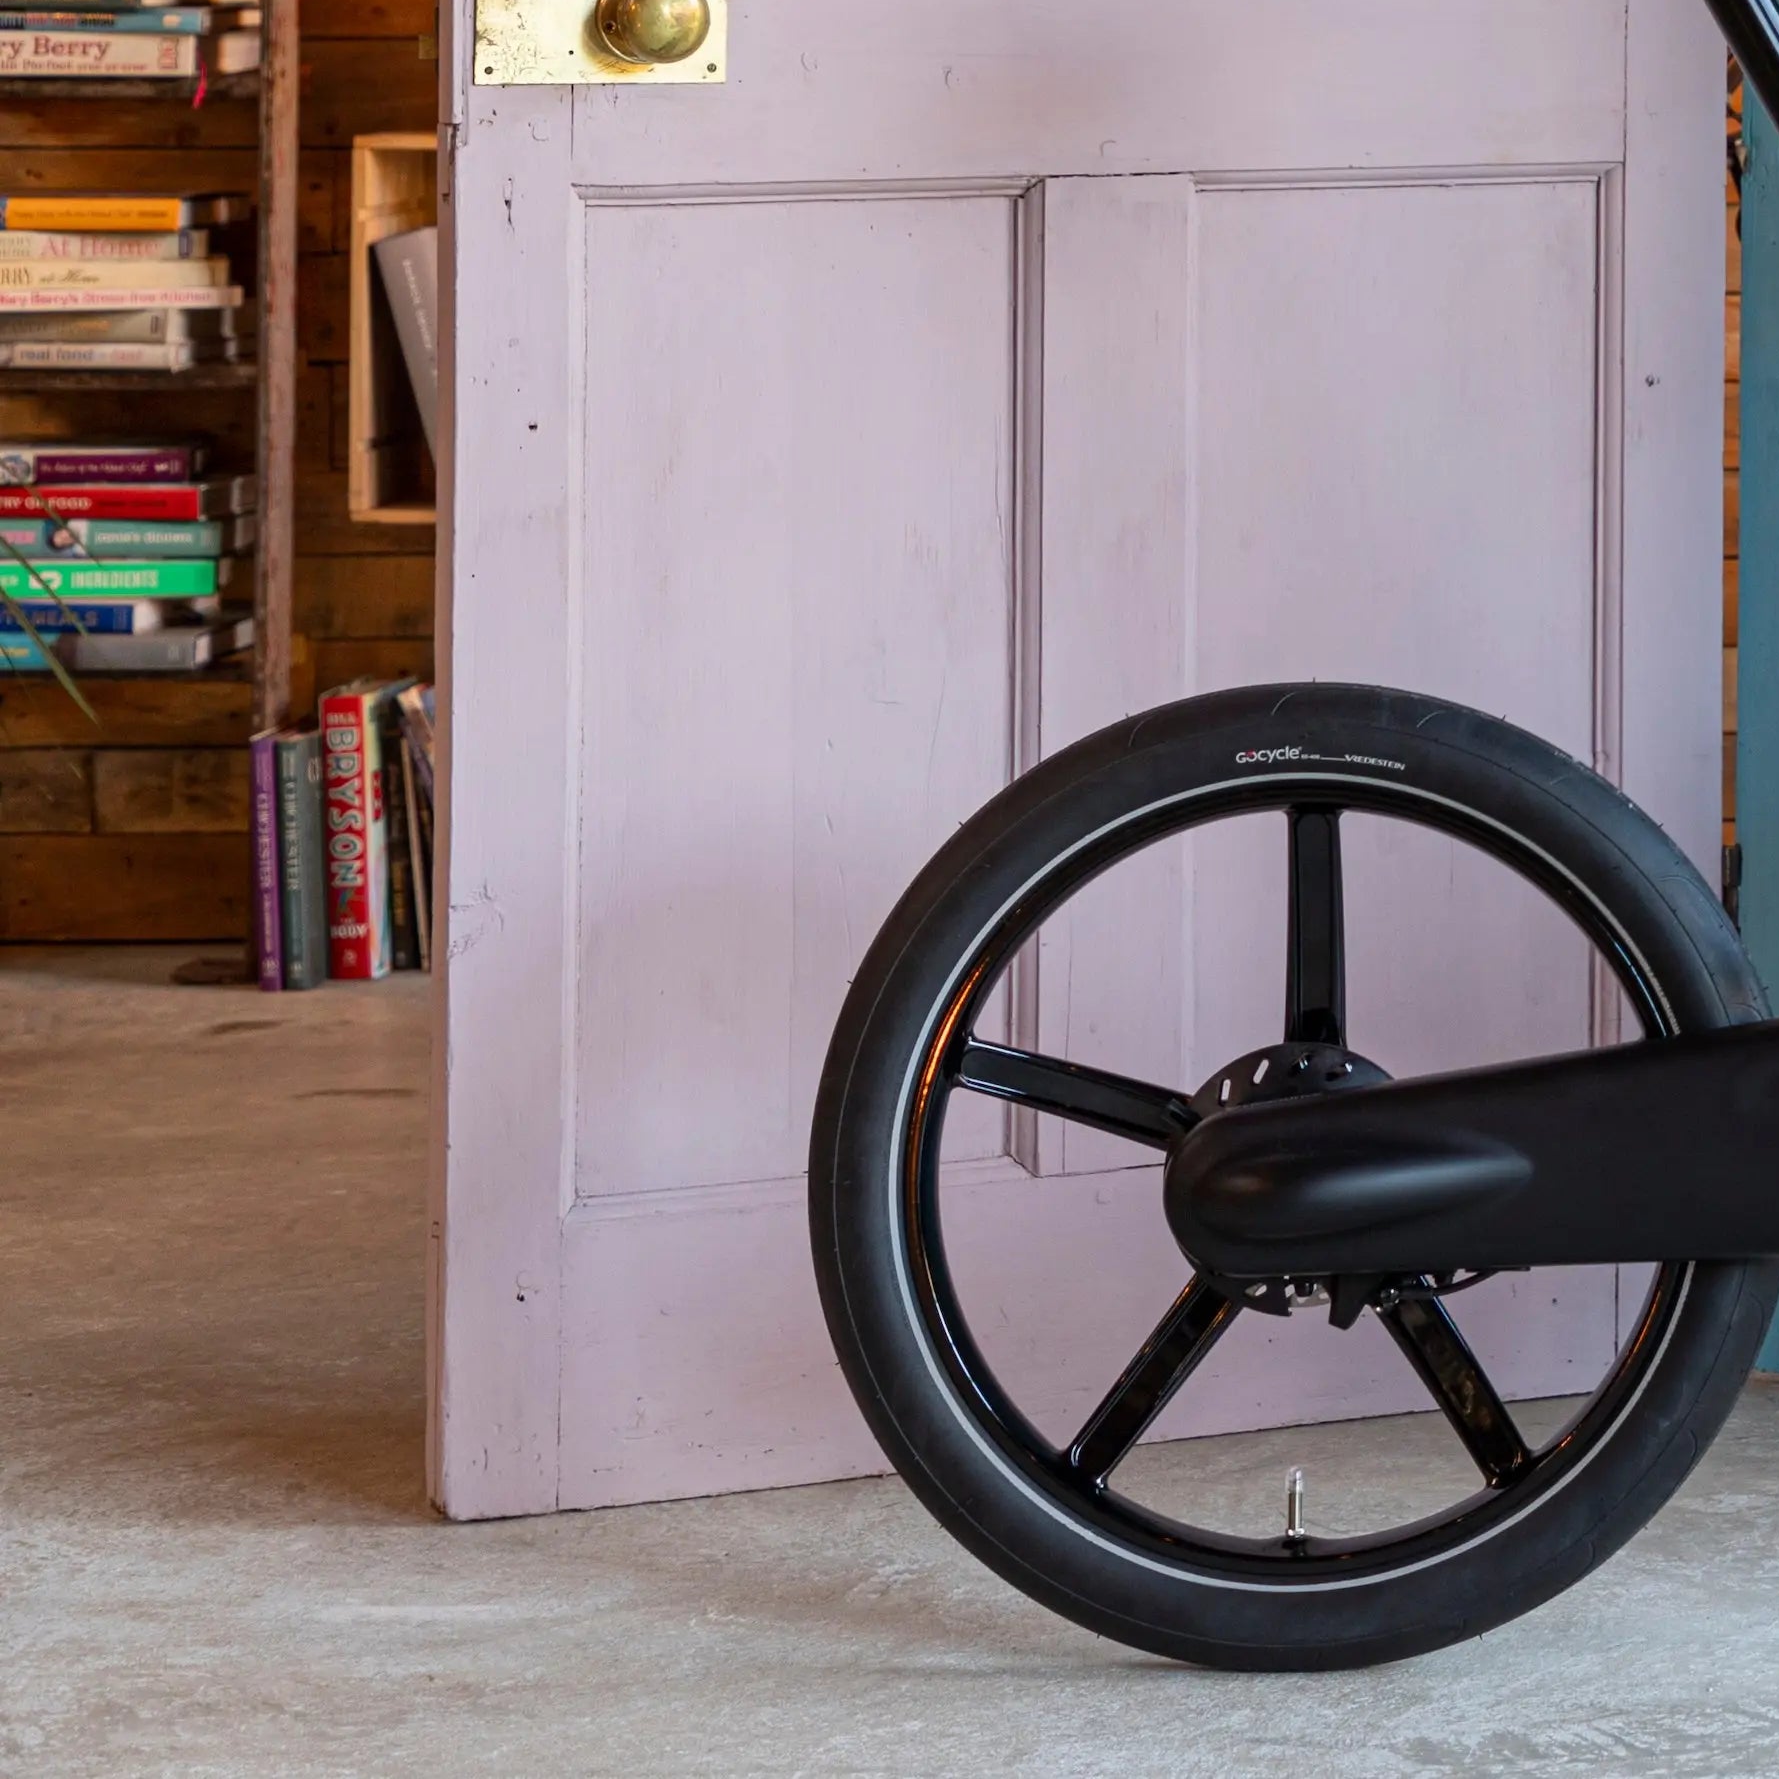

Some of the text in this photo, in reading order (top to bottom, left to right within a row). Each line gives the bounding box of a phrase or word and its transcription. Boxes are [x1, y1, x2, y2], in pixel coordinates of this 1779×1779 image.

[33, 35, 110, 60] Berry
[70, 570, 159, 589] INGREDIENTS
[1344, 753, 1405, 771] VREDESTEIN
[325, 726, 364, 890] BRYSON
